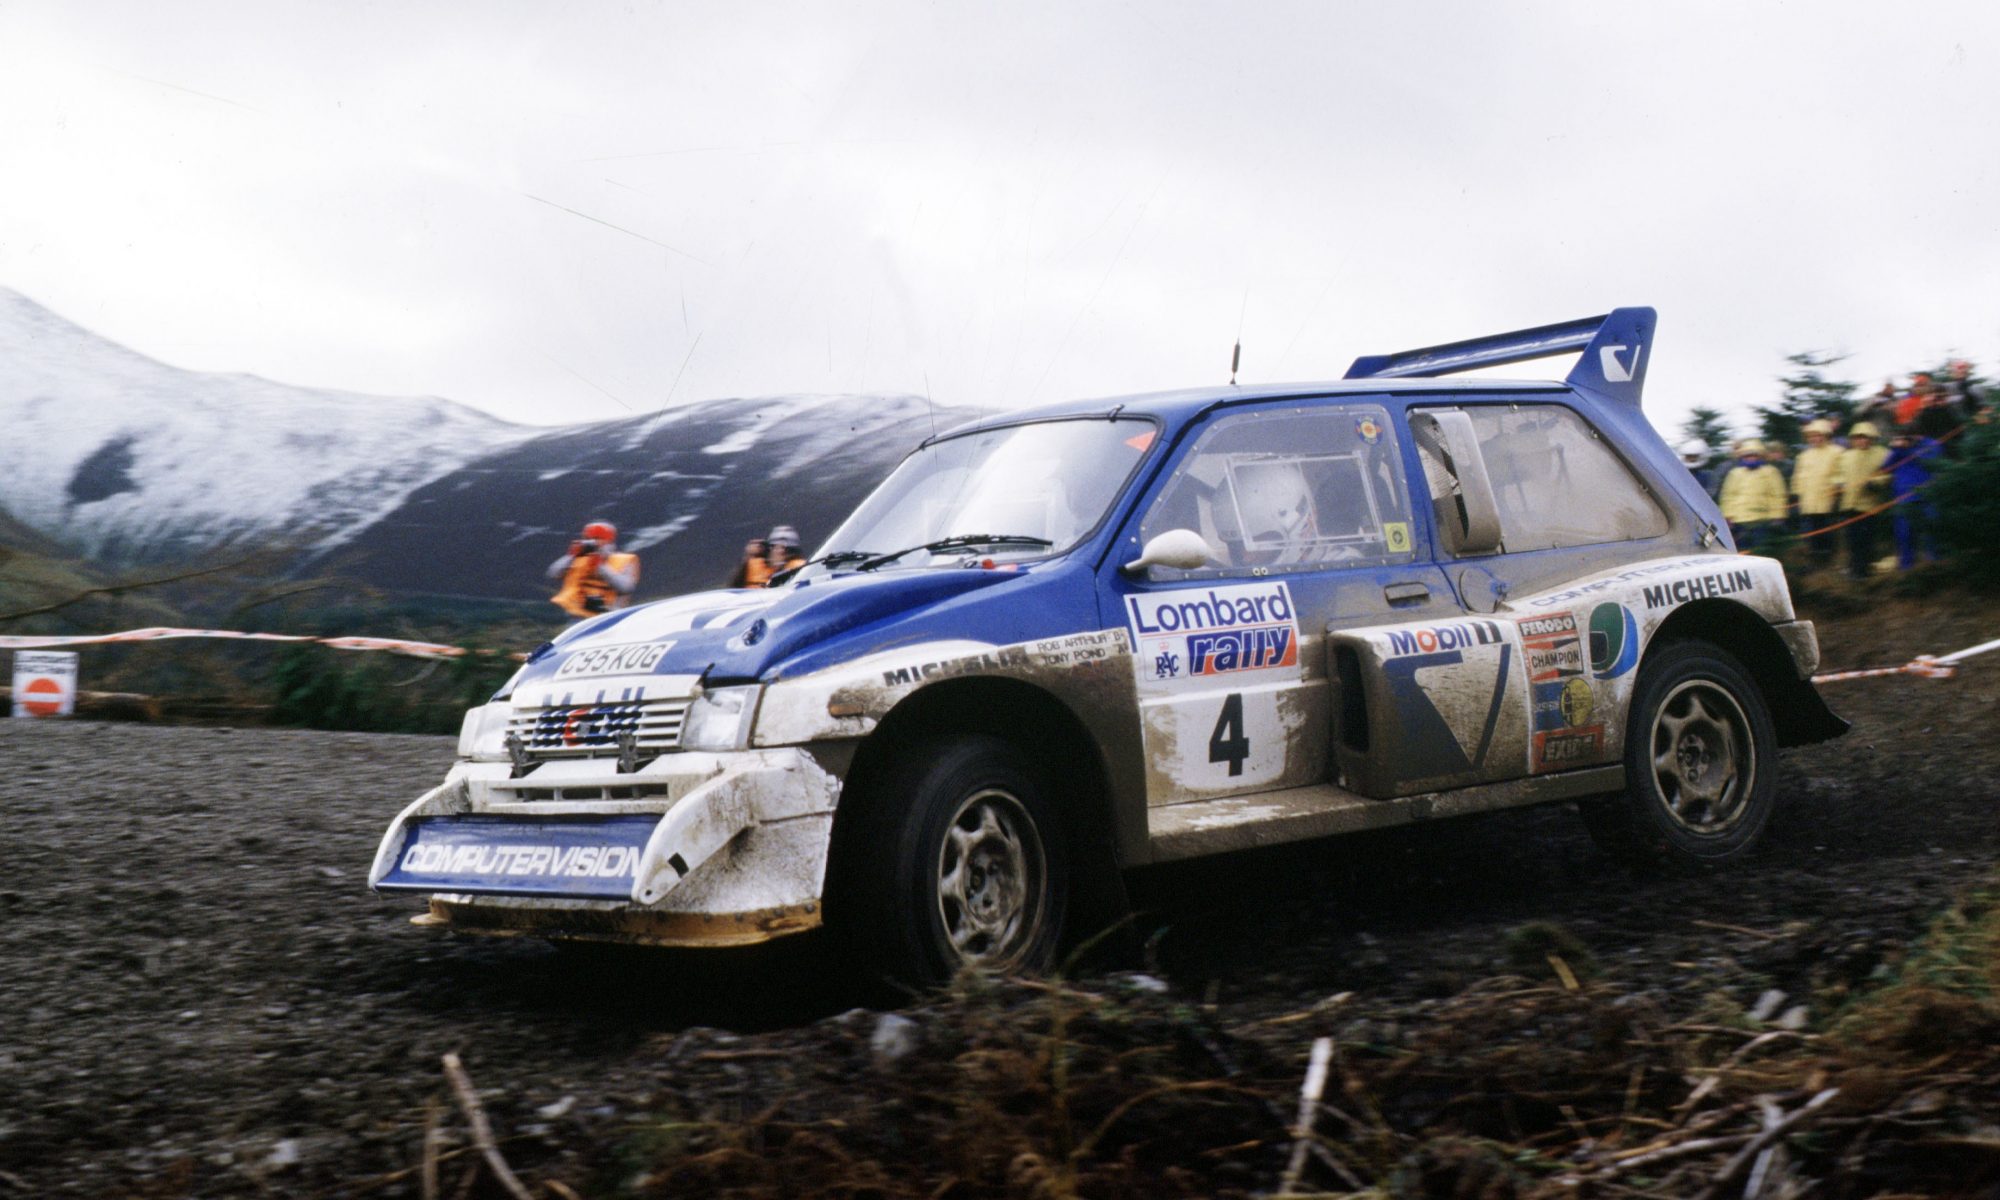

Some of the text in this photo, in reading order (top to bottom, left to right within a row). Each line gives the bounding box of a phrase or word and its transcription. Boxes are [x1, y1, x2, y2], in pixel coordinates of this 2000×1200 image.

[1531, 556, 1738, 607] COMPUTERV
[1642, 569, 1753, 609] MICHELIN
[1130, 585, 1292, 633] Lombard
[1386, 624, 1472, 655] Mobil
[1521, 618, 1573, 636] FERODO
[1037, 640, 1060, 652] ROB
[1044, 652, 1069, 665] TONY
[1073, 647, 1106, 660] POND
[1155, 625, 1292, 677] RAC rally
[1531, 650, 1580, 668] CHAMPION
[1208, 693, 1250, 777] 4
[401, 845, 645, 877] COMPUTERVISION
